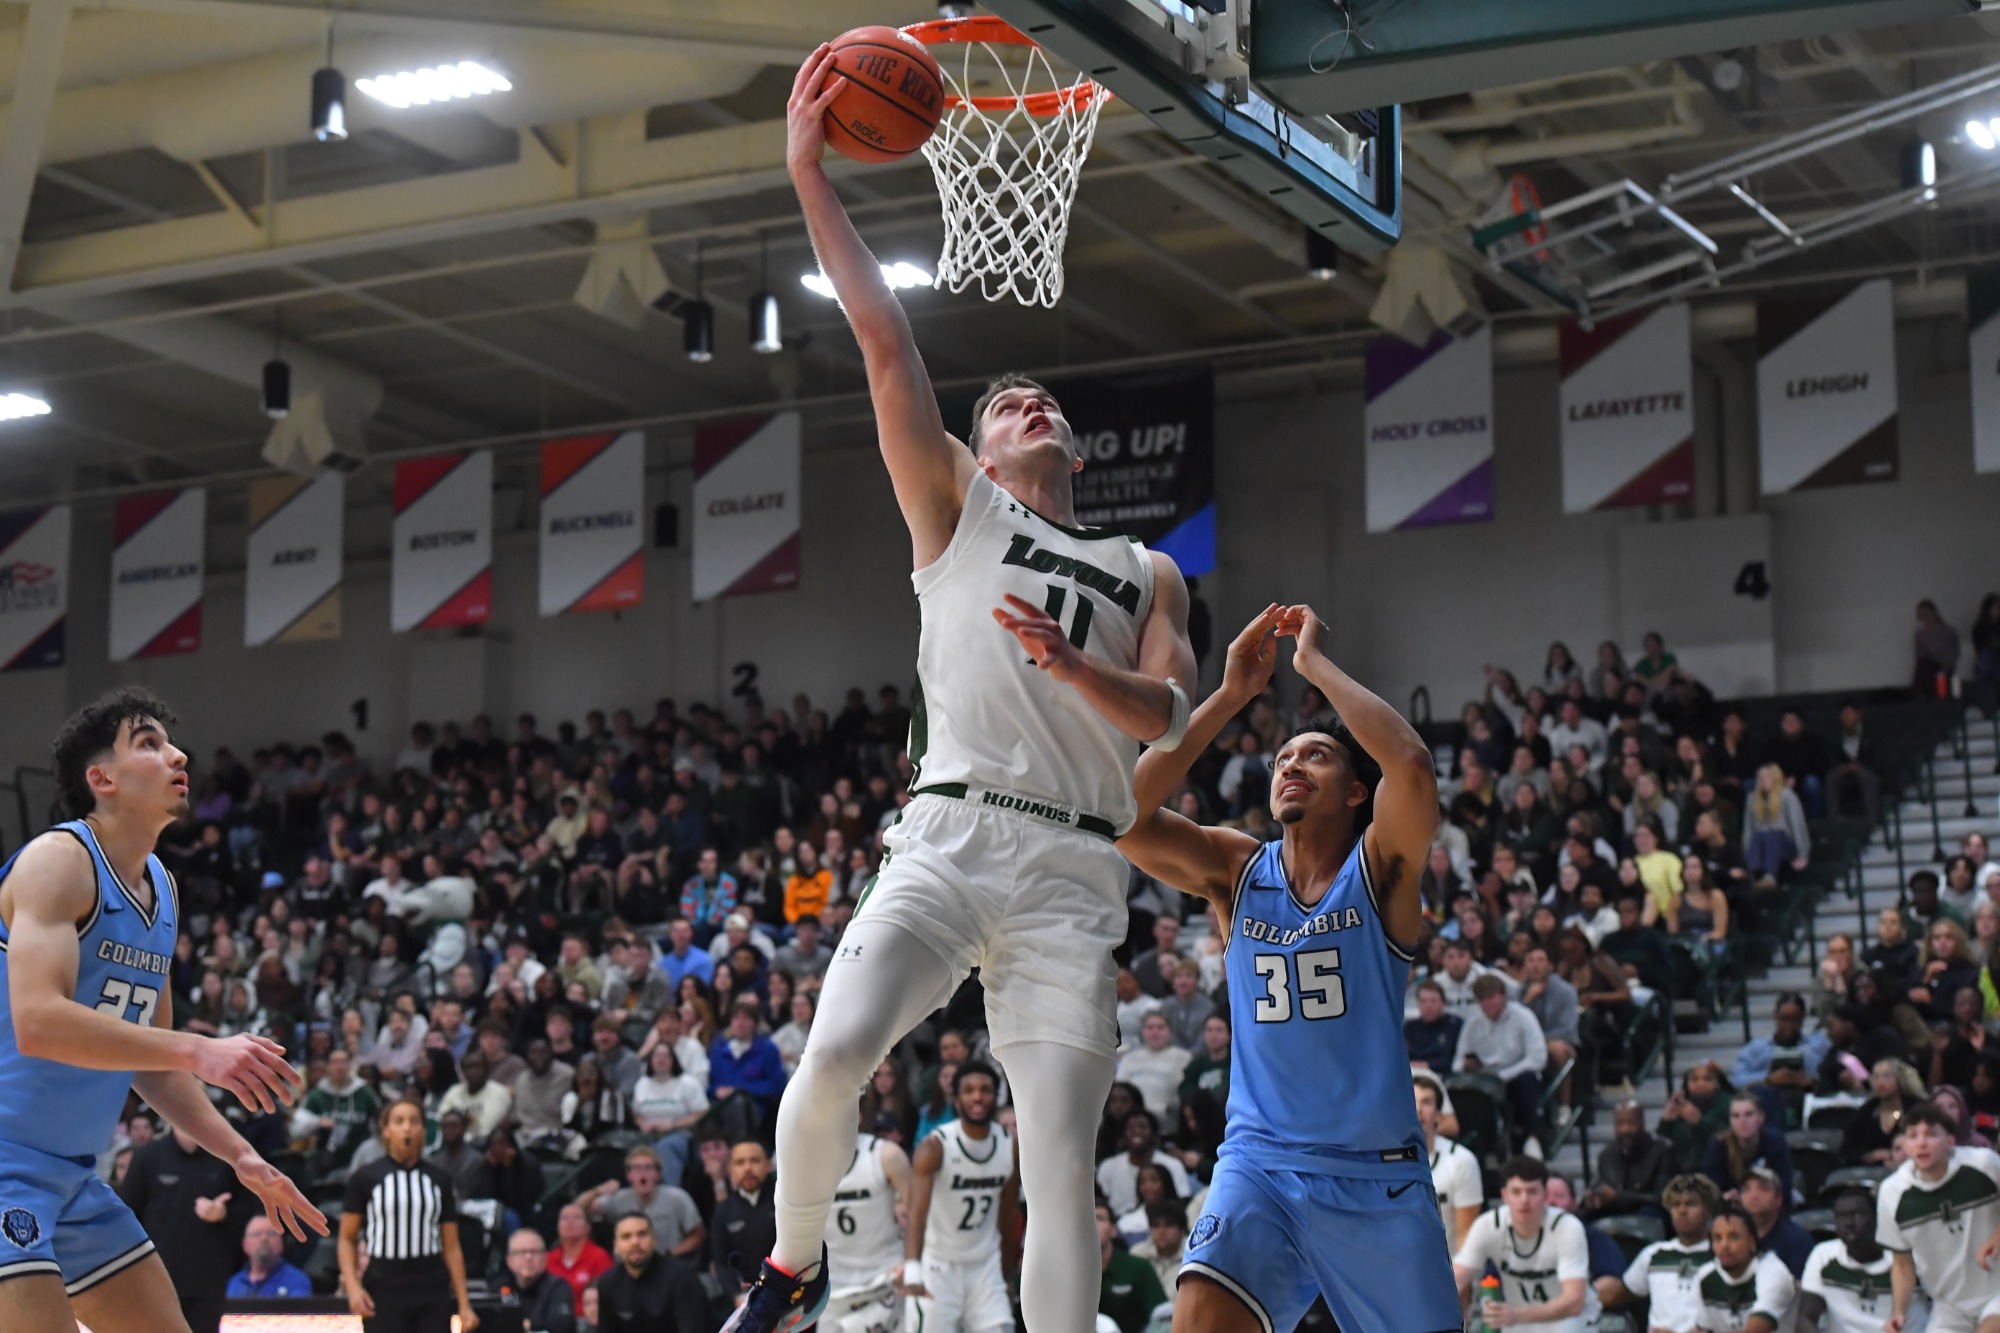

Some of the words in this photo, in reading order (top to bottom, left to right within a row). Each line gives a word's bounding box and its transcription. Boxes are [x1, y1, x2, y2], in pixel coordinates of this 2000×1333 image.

[856, 53, 898, 85] THE
[1786, 372, 1868, 399] LEHIGH
[1569, 391, 1685, 423] LAFAYETTE
[1130, 421, 1187, 457] UP!
[1371, 421, 1422, 443] HOLY
[1426, 415, 1488, 439] CROSS
[708, 492, 785, 518] COLGATE
[549, 511, 635, 536] BUCKNELL
[271, 546, 319, 566] ARMY
[410, 530, 477, 552] BOSTON
[1002, 533, 1141, 617] LOYOLA
[1734, 561, 1770, 600] 4
[732, 660, 759, 697] 2
[350, 698, 369, 730] 1
[983, 790, 1071, 824] HOUNDS
[1242, 907, 1363, 946] COLUMBIA
[1254, 947, 1347, 1024] 35
[837, 1206, 856, 1235] 6
[958, 1195, 992, 1230] 23
[1517, 1281, 1549, 1304] 14
